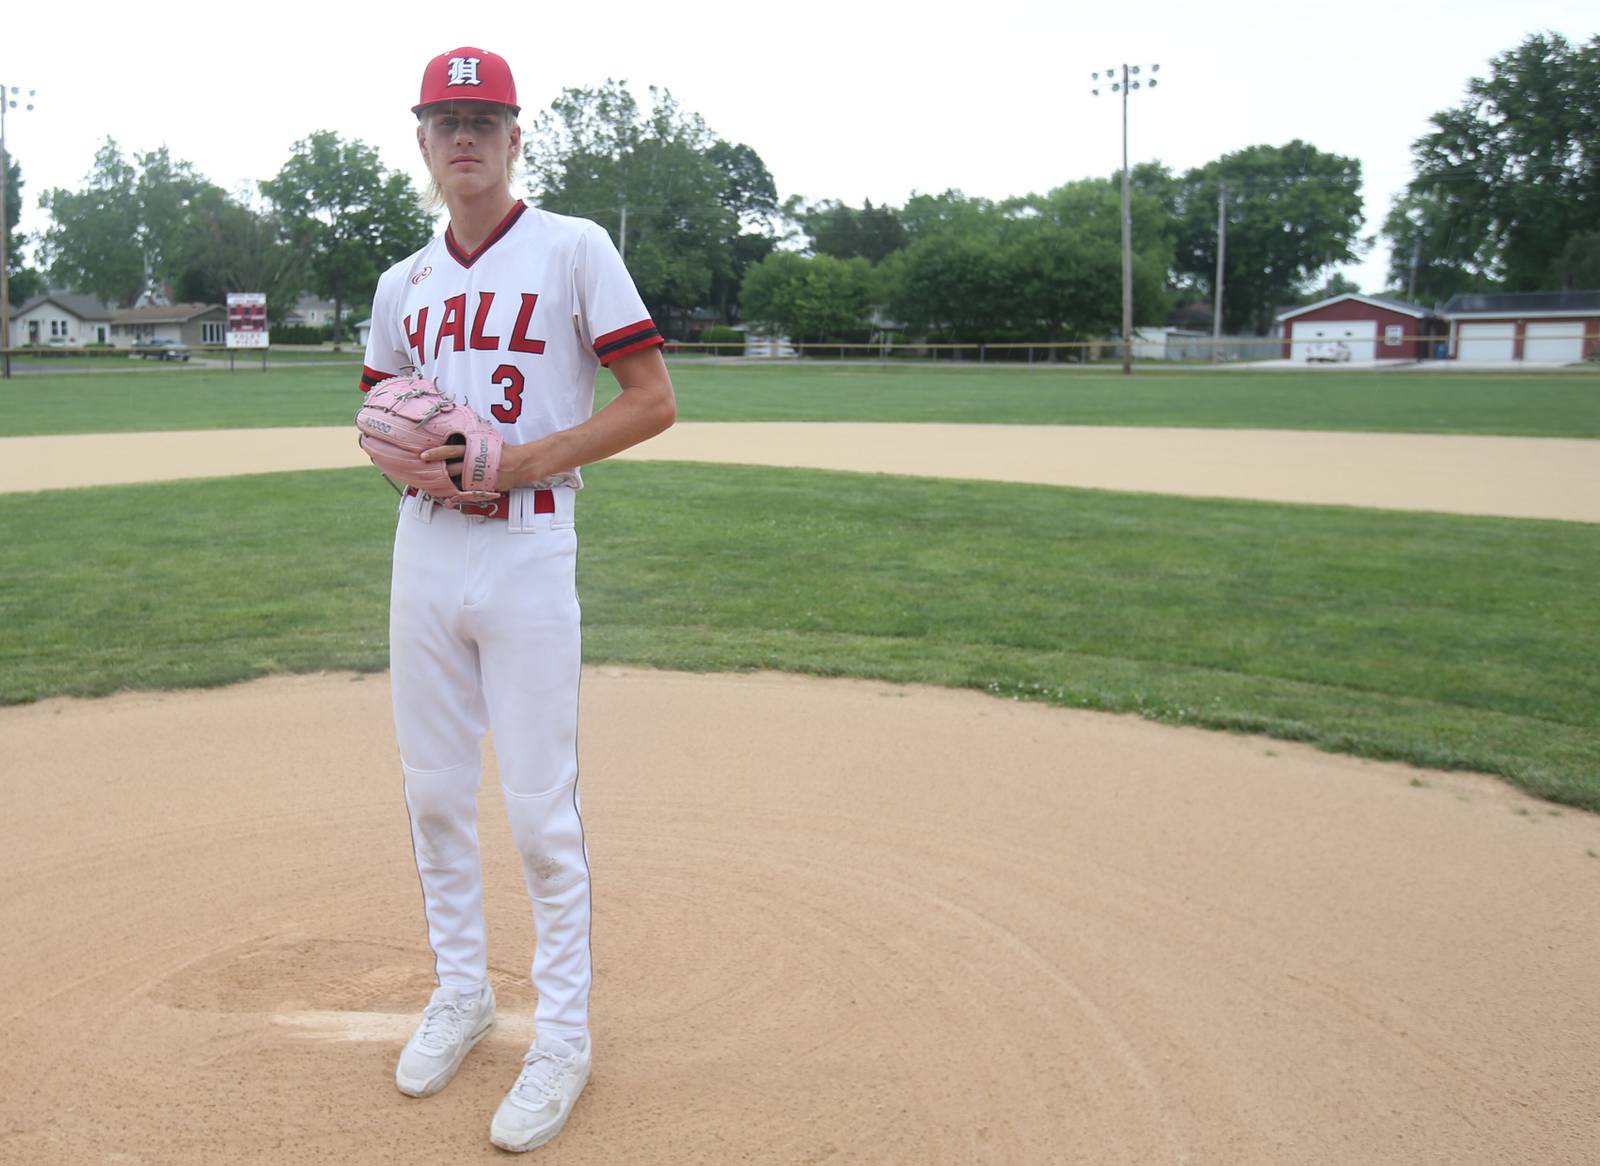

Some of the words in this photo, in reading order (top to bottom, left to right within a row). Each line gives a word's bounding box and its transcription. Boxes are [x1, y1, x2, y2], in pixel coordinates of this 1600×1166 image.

[447, 57, 481, 87] H
[403, 291, 546, 366] HALL
[490, 364, 525, 424] 3
[472, 436, 489, 483] Wilson
